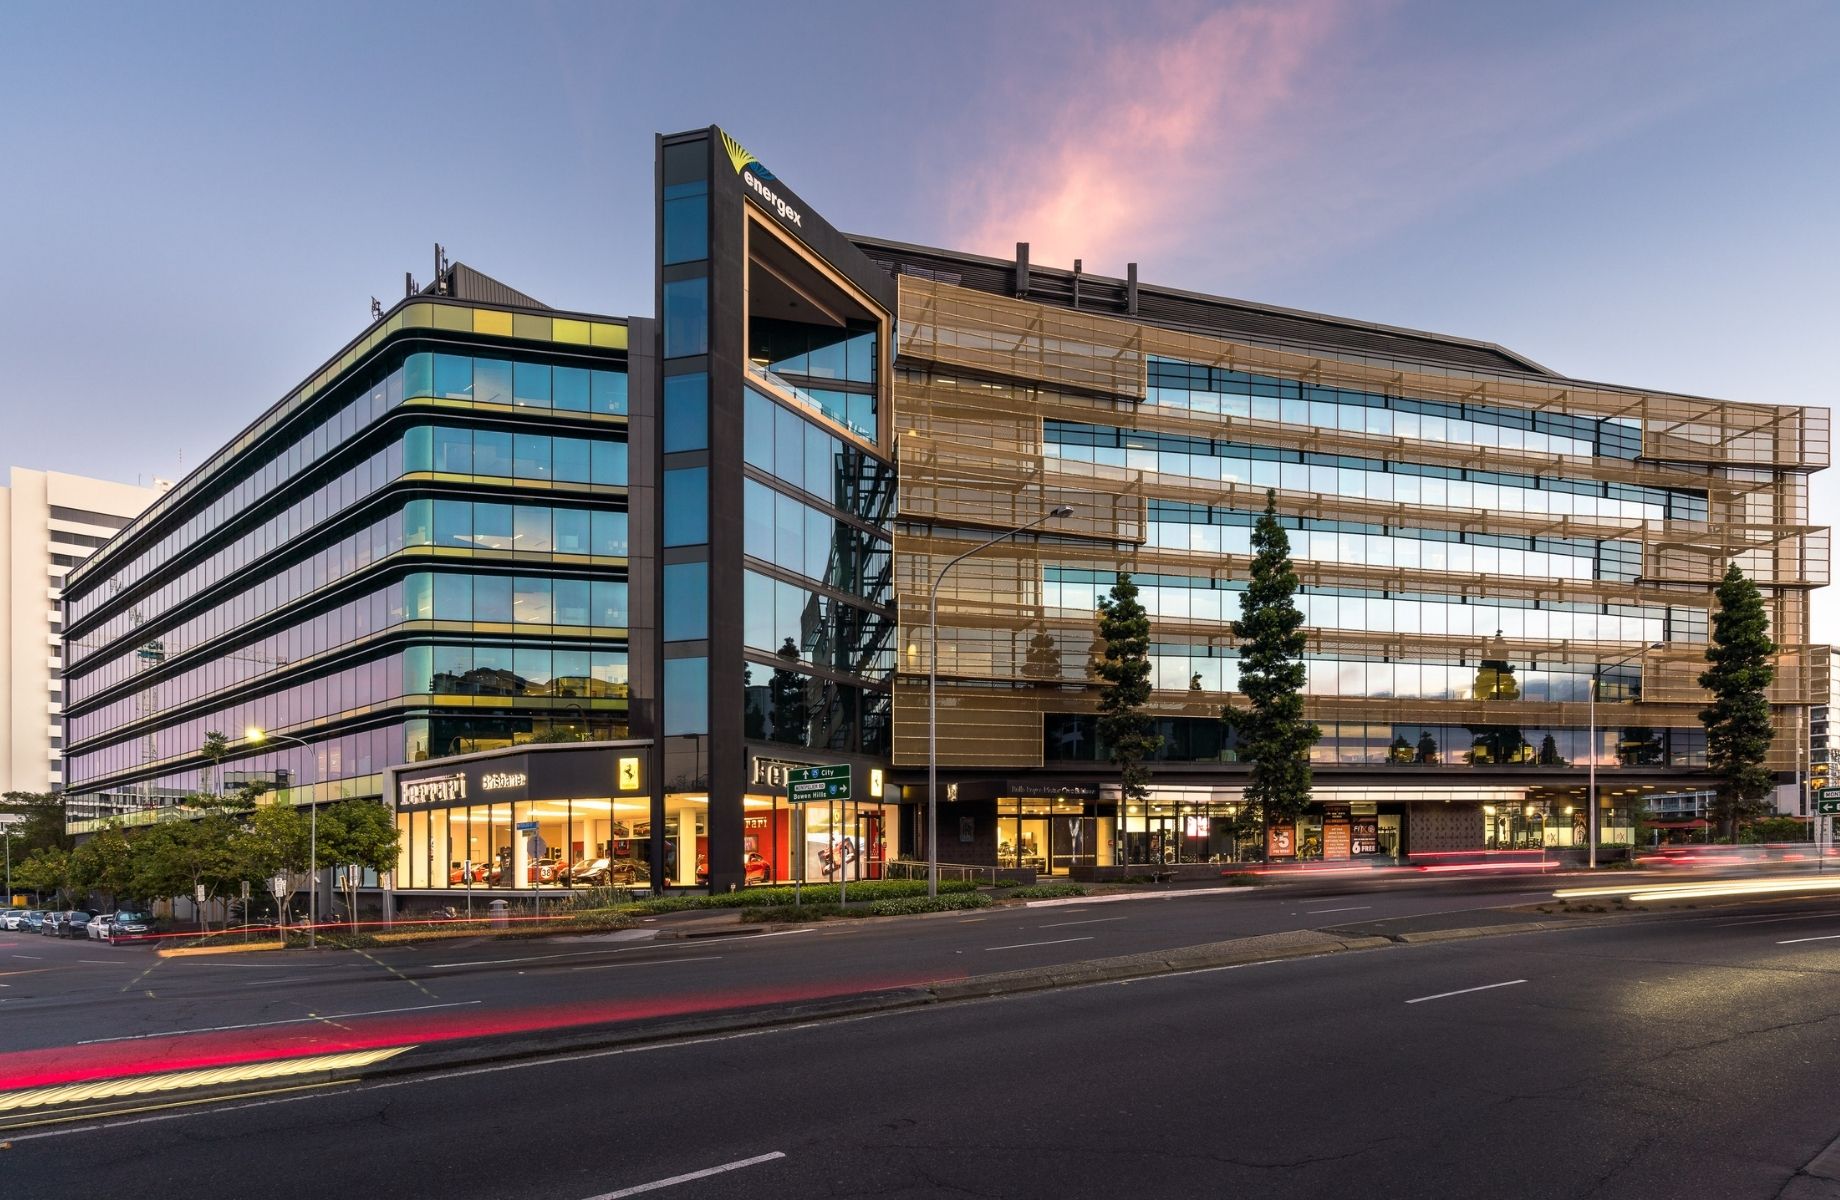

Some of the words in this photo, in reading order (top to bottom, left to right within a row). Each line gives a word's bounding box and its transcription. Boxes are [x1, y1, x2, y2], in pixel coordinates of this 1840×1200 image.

[744, 170, 802, 227] energex
[821, 769, 835, 777] City
[400, 772, 467, 805] Ferrari
[482, 773, 527, 790] Brisbane
[1352, 841, 1361, 854] 6
[542, 868, 551, 877] 38
